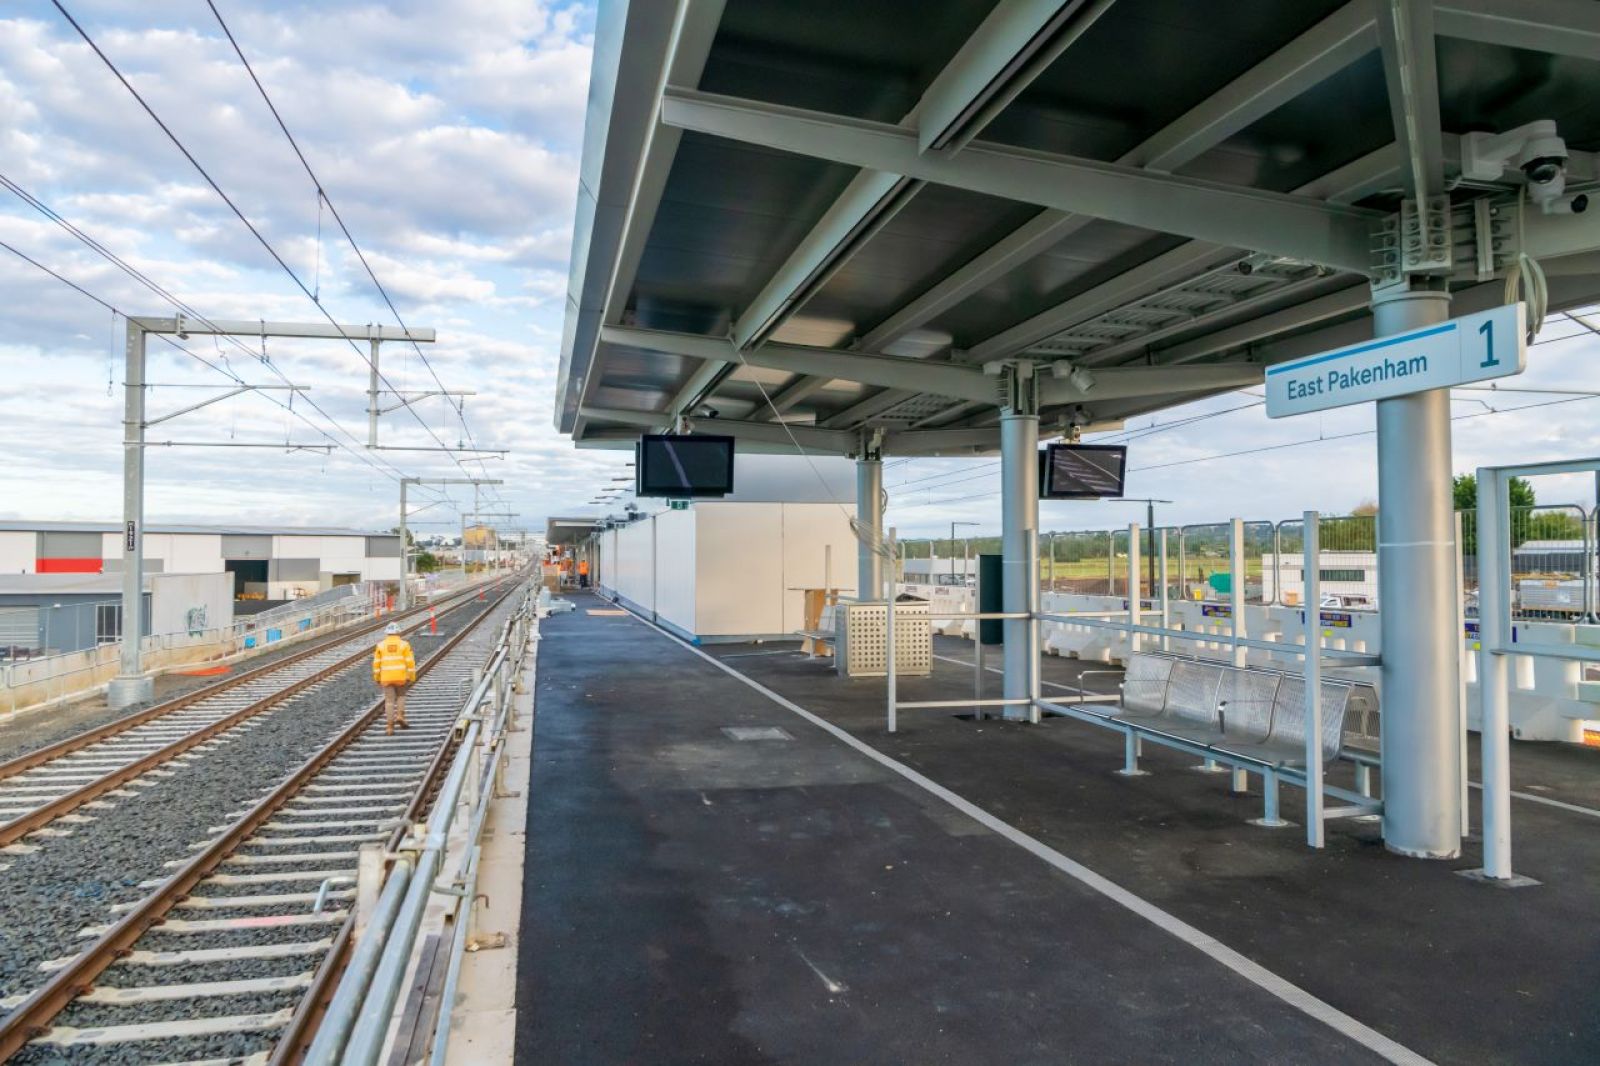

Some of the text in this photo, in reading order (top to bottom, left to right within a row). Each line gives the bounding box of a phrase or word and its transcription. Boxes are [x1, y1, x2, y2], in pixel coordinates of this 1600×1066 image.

[1478, 319, 1500, 368] 1
[1288, 355, 1427, 400] East Pakenham
